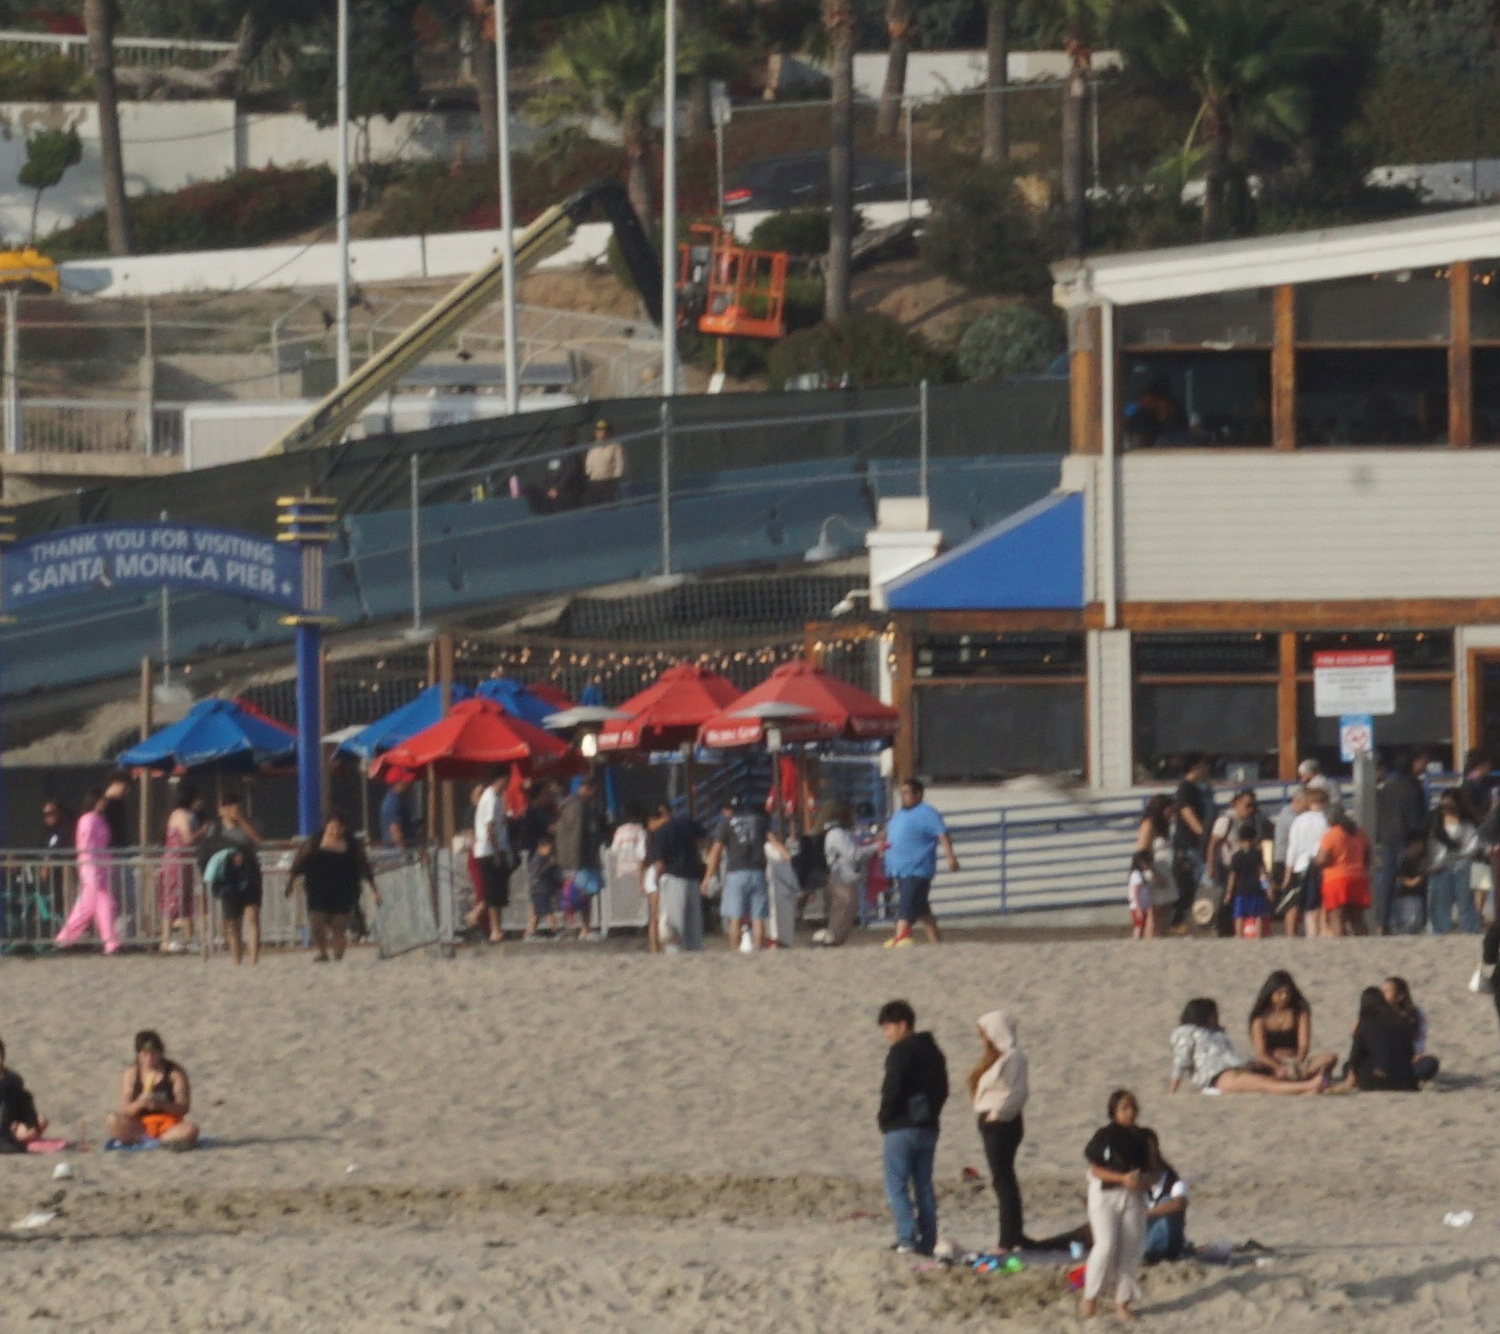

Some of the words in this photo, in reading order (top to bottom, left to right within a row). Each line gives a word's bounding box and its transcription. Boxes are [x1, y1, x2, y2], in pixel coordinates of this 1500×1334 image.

[30, 535, 98, 563] THANK
[104, 531, 146, 551] YOU
[151, 529, 189, 551] FOR
[193, 533, 275, 566] VISITING
[27, 557, 106, 594] SANTA
[115, 555, 219, 582] MONICA
[226, 561, 277, 592] PIER
